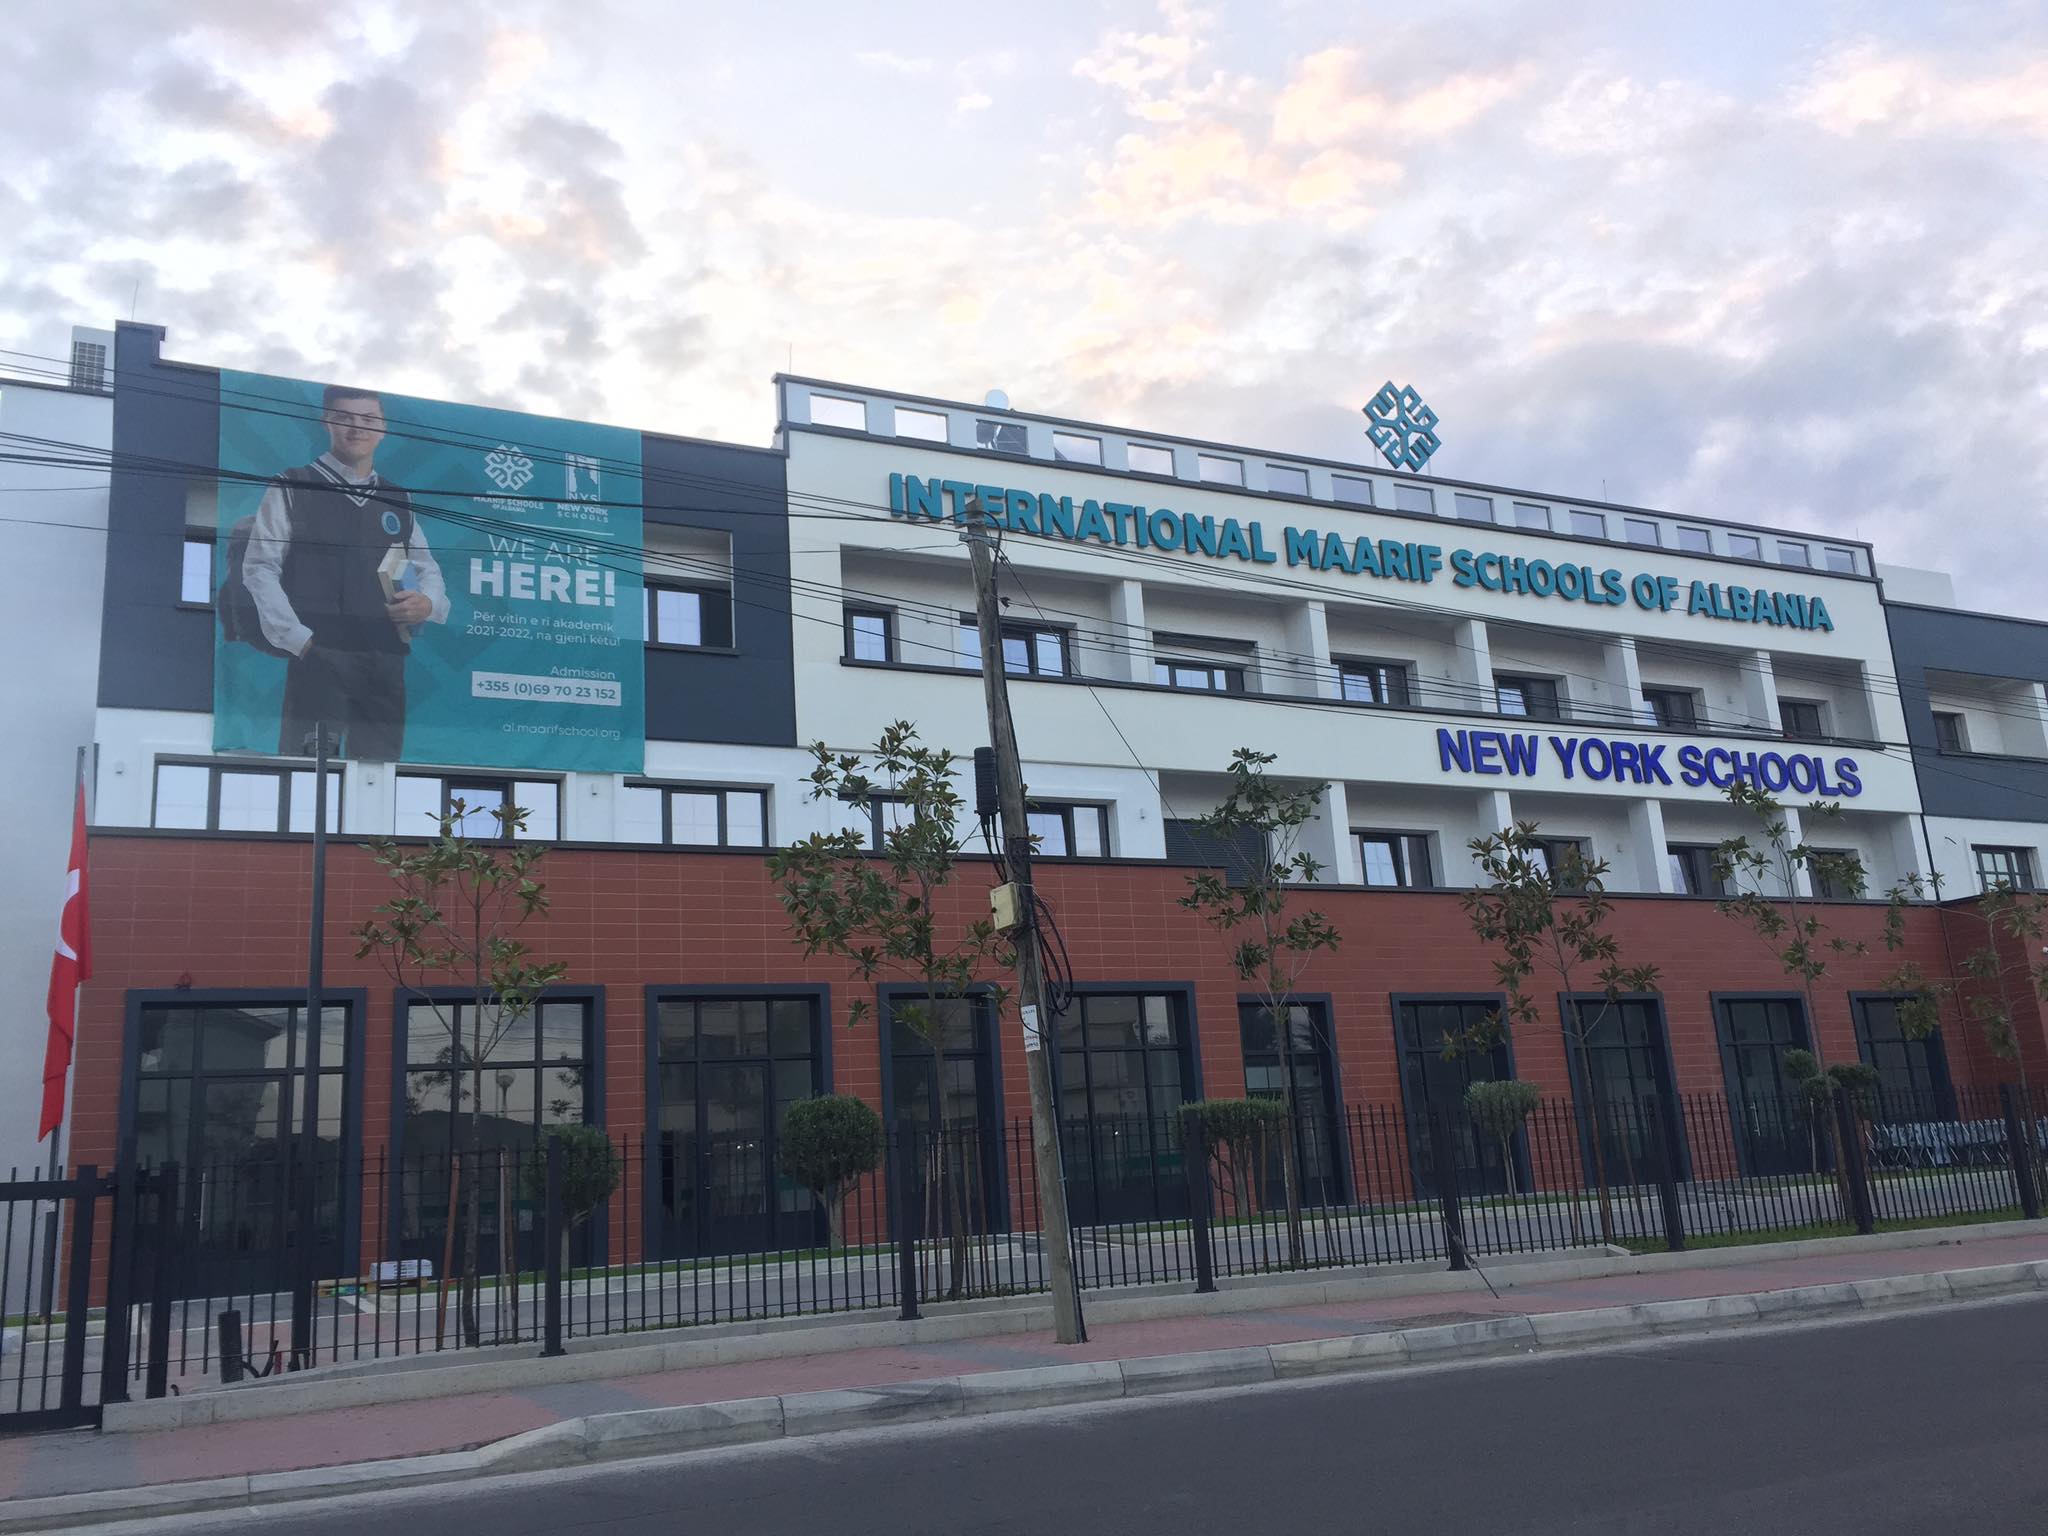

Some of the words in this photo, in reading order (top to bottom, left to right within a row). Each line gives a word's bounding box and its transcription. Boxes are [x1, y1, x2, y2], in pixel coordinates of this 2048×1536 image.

[507, 498, 544, 510] SCHOOLS
[557, 502, 580, 512] NEW
[583, 505, 608, 516] YORK
[558, 510, 608, 523] SCHOOLS
[488, 533, 535, 561] WE
[544, 541, 599, 568] ARE
[889, 472, 1277, 564] INTERNATIONAL
[1284, 526, 1443, 582] MAARIF
[1450, 548, 1627, 606] SCHOOLS
[1632, 573, 1680, 612] OF
[1688, 580, 1834, 631] ALBANIA
[470, 557, 616, 607] HERE!
[473, 610, 496, 622] Për
[499, 613, 527, 625] vitin
[530, 617, 538, 626] e
[542, 615, 550, 627] ri
[553, 618, 615, 633] akademik
[466, 624, 533, 640] 2021-2022,
[537, 631, 551, 641] na
[555, 632, 586, 644] gjeni
[550, 665, 616, 680] Admission
[477, 680, 510, 692] +355
[514, 682, 550, 696] (0)69
[554, 685, 571, 696] 70
[575, 686, 591, 698] 23
[595, 688, 616, 700] 152
[1436, 728, 1539, 777] NEW
[1549, 736, 1672, 786] YORK
[1678, 745, 1863, 797] SCHOOLS
